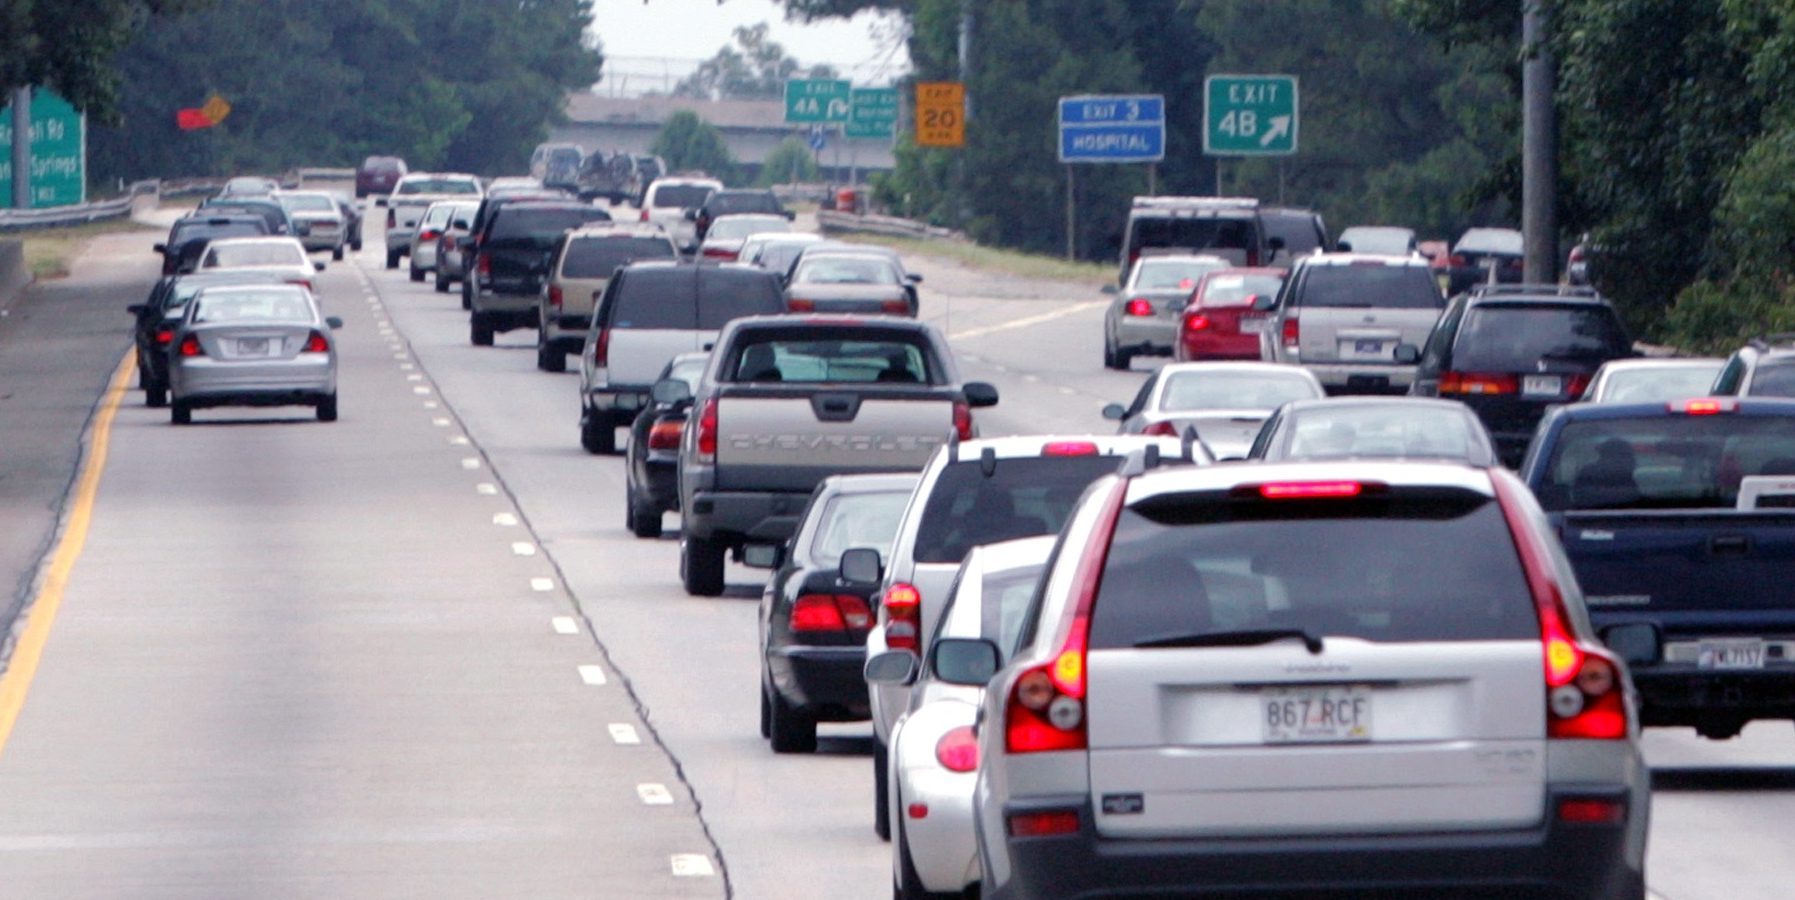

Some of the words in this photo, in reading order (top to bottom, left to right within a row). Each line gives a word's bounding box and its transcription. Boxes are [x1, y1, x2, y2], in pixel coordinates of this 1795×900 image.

[1230, 84, 1278, 103] EXIT
[793, 97, 820, 115] 4A
[1083, 103, 1118, 119] EXIT
[1126, 100, 1140, 120] 3
[924, 109, 956, 128] 20
[1219, 110, 1258, 137] 4B
[1073, 133, 1151, 151] HOSPITAL
[731, 434, 943, 450] CHEVROLET
[1267, 699, 1313, 728] 867
[1322, 698, 1366, 726] RCF
